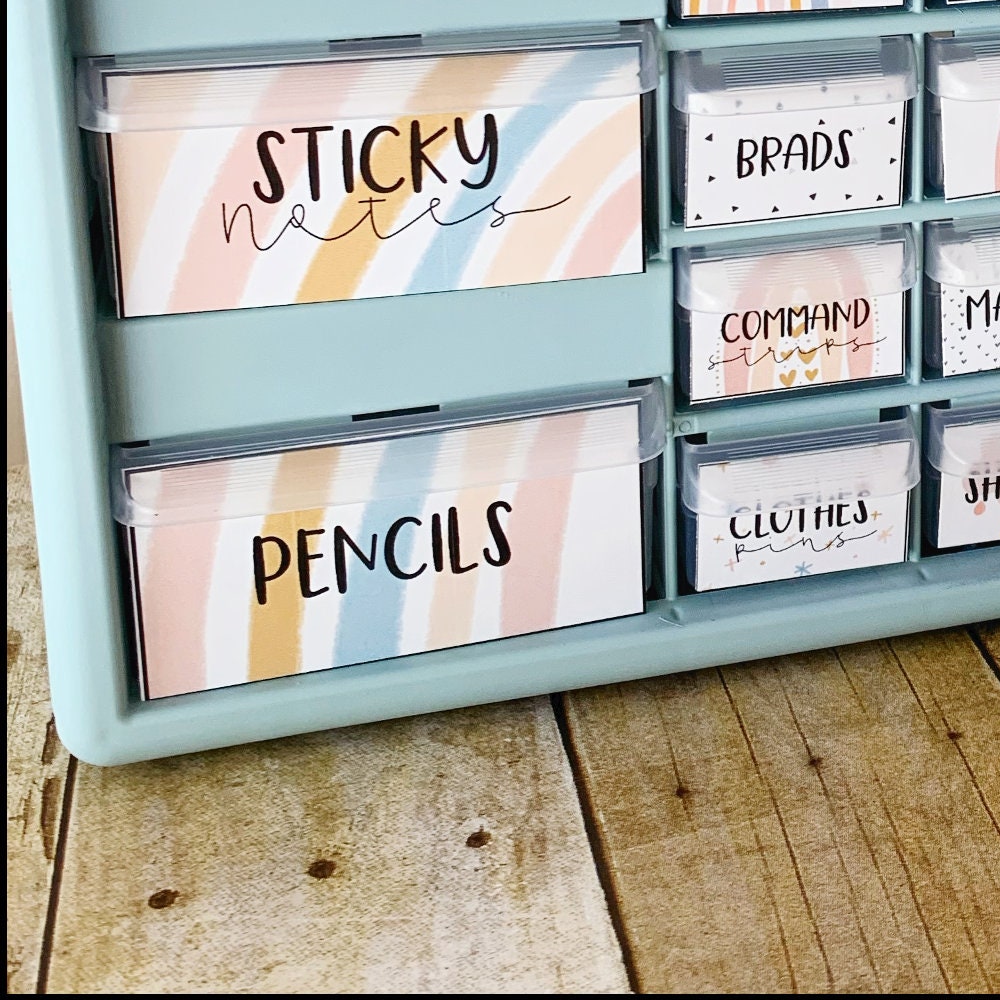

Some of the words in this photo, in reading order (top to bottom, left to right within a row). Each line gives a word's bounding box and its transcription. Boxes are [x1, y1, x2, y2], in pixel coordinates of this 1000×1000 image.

[253, 113, 498, 204] STICKY
[736, 129, 853, 179] BRADS
[222, 195, 572, 251] notes
[720, 297, 871, 343] COMMAND
[707, 335, 887, 371] strips
[729, 489, 871, 539] CLOTHES
[252, 500, 513, 605] PENCILS
[735, 530, 878, 562] pins
